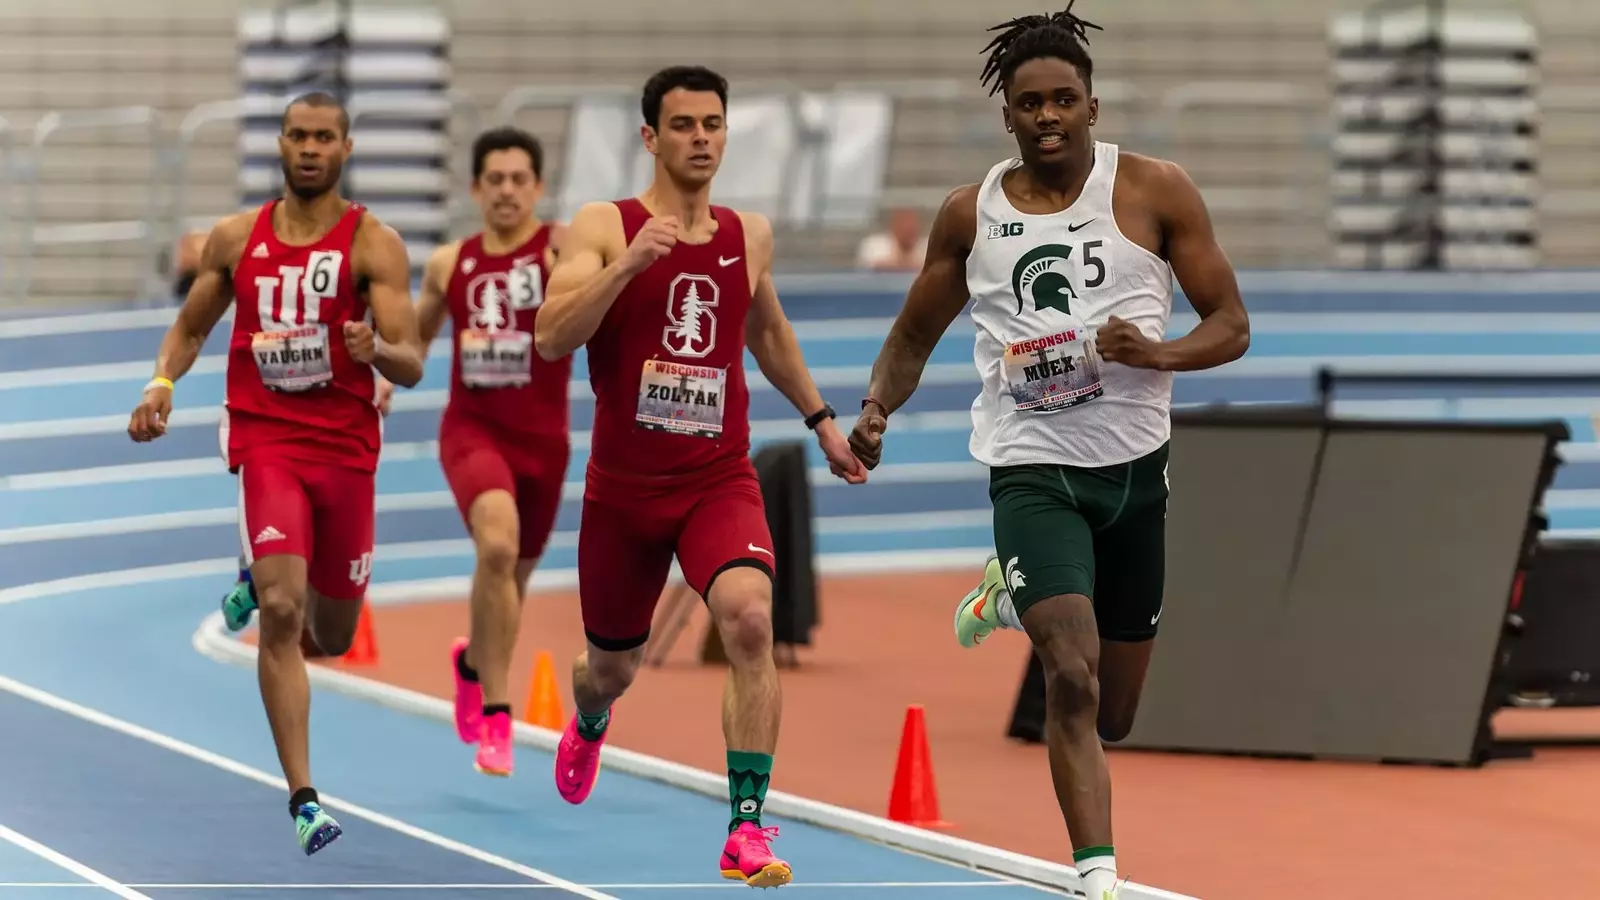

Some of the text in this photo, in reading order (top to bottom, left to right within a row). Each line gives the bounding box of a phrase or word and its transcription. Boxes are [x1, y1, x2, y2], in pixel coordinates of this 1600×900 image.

[312, 256, 332, 292] 6
[1083, 240, 1106, 288] 5
[519, 269, 535, 304] 3
[258, 347, 324, 365] VAUGHN
[1012, 330, 1076, 356] WISCONSIN
[655, 362, 719, 380] WISCONSIN
[1023, 355, 1076, 382] MUEX
[647, 383, 719, 407] ZOLTAK
[1050, 392, 1078, 402] WISCONSIN
[1078, 383, 1100, 395] BADGERS
